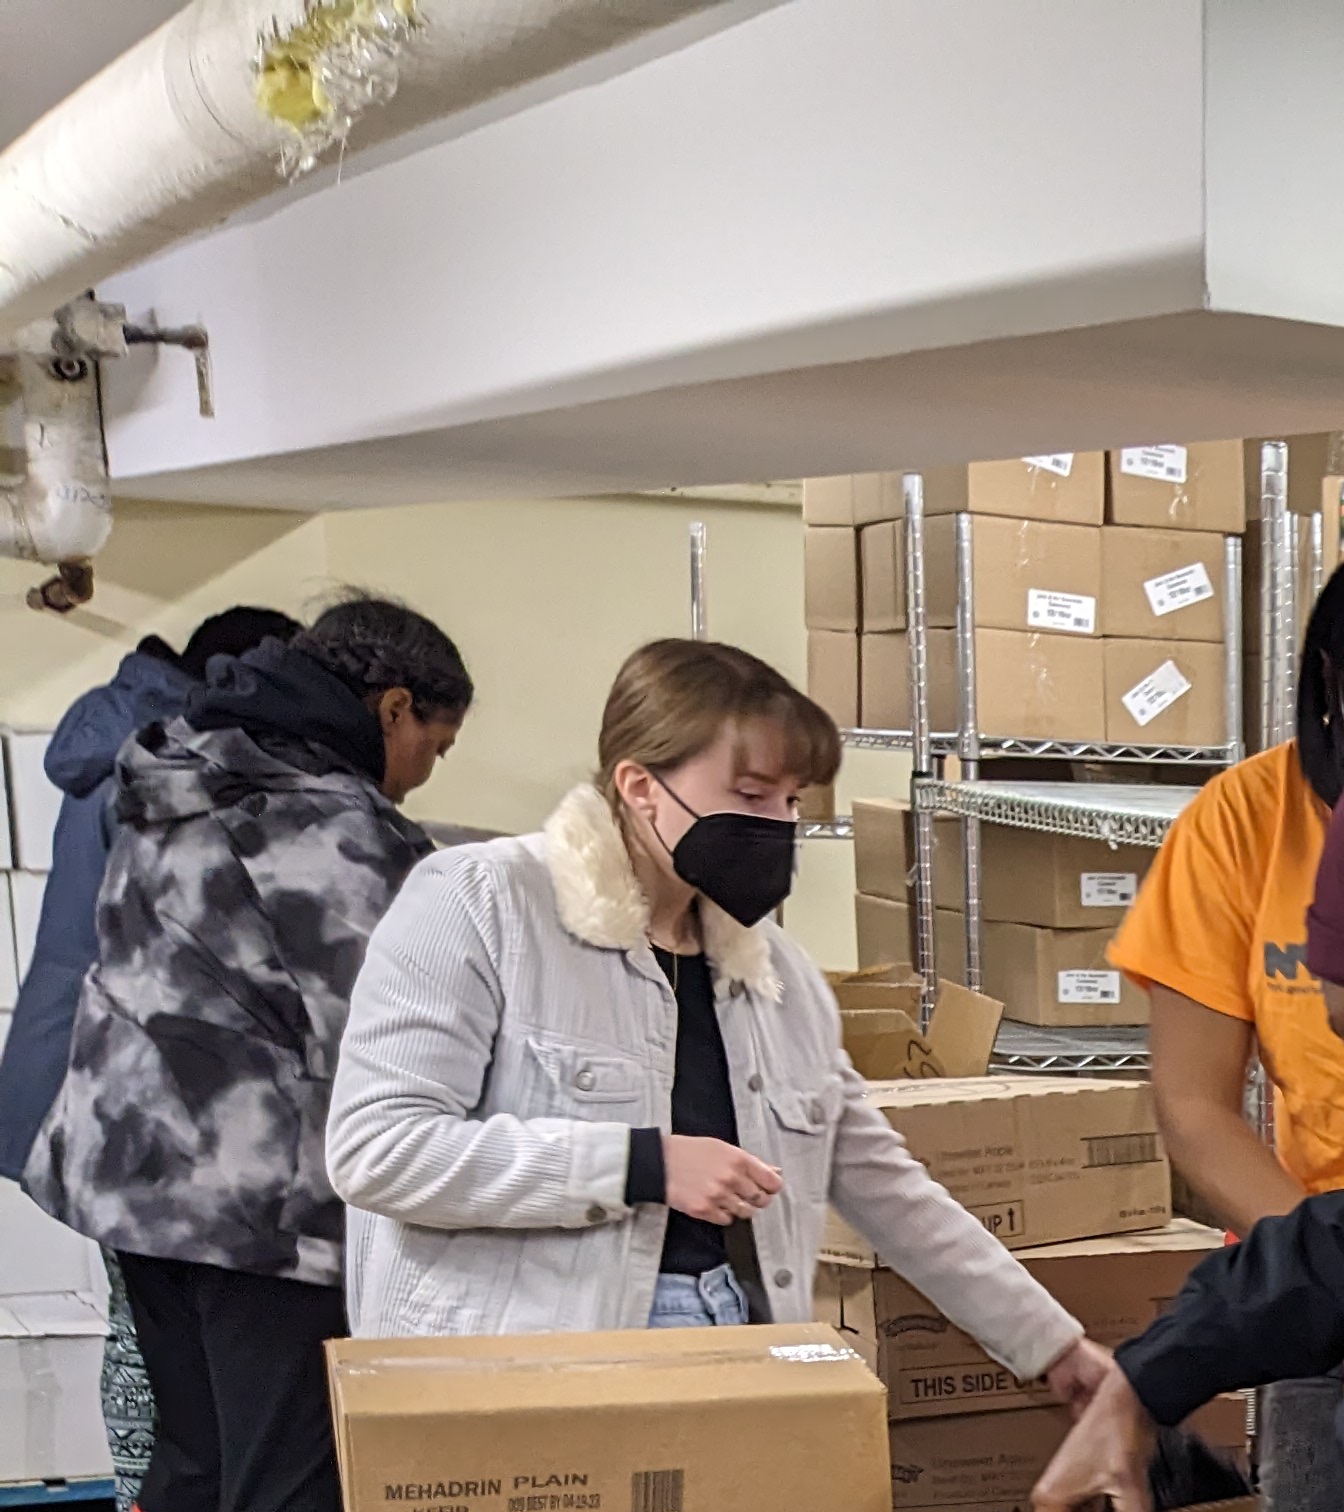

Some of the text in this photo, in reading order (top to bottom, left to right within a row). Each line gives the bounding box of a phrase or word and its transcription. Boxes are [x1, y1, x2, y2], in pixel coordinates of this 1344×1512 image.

[911, 1376, 961, 1399] THIS
[963, 1372, 1009, 1393] SIDE
[385, 1473, 589, 1501] MEHADRIN PLAIN
[526, 1495, 548, 1511] BEST
